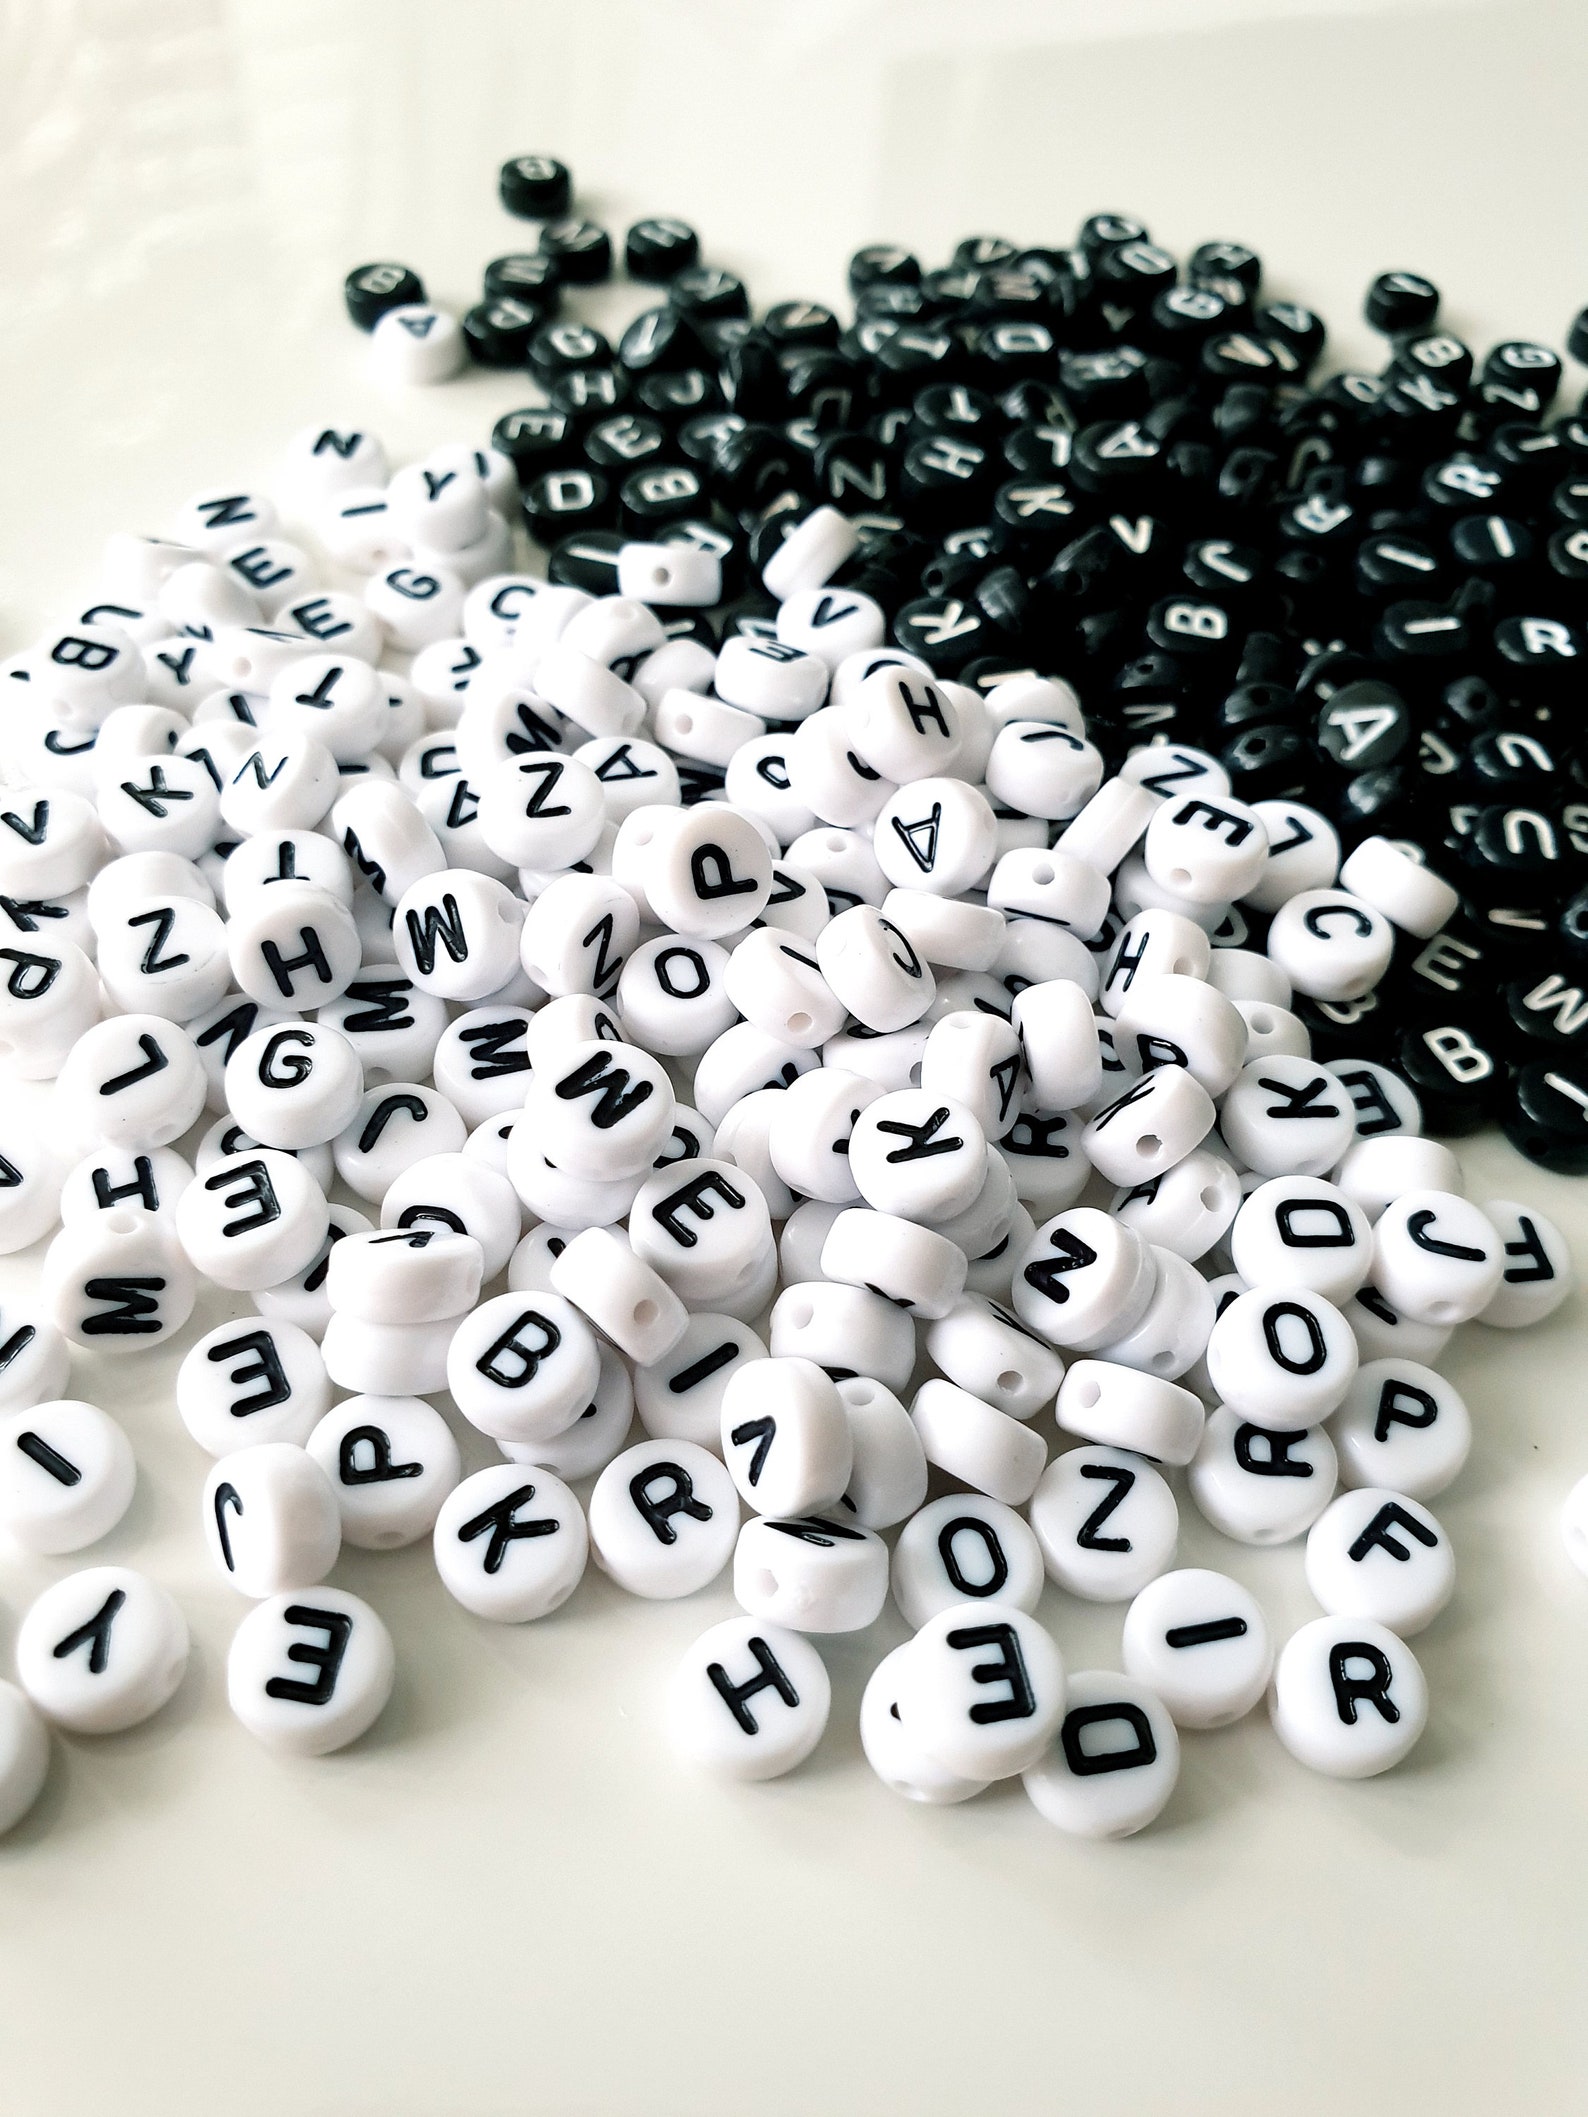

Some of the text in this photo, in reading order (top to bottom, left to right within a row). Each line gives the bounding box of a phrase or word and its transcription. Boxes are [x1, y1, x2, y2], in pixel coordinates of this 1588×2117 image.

[1410, 337, 1464, 368] B
[571, 370, 615, 406] H
[1399, 375, 1457, 411] K
[505, 413, 566, 441] E
[597, 414, 661, 458] E
[1097, 420, 1160, 458] A
[921, 435, 984, 478] H
[1437, 464, 1501, 498] R
[423, 471, 457, 500] Y
[547, 469, 595, 511] D
[639, 467, 699, 501] B
[341, 503, 387, 518] I
[1109, 514, 1154, 554] V
[1376, 544, 1436, 571] I
[1487, 516, 1516, 558] I
[231, 548, 293, 588] E
[386, 569, 440, 600] G
[291, 598, 352, 640] E
[908, 600, 982, 645] K
[1164, 602, 1228, 640] B
[1404, 617, 1460, 634] I
[1519, 617, 1577, 657] R
[51, 637, 120, 671] B
[158, 648, 193, 684] Y
[296, 668, 341, 708] T
[899, 681, 950, 738] H
[1327, 704, 1398, 762] A
[595, 745, 657, 782] A
[121, 766, 193, 817] K
[520, 762, 571, 818] Z
[892, 802, 941, 873] A
[1173, 801, 1253, 846] E
[1503, 808, 1558, 860] U
[691, 843, 758, 900] P
[1305, 906, 1372, 939] C
[261, 926, 333, 997] H
[654, 947, 710, 999] O
[1105, 931, 1149, 992] H
[1410, 934, 1480, 991] E
[100, 1034, 168, 1095] L
[259, 1030, 314, 1088] G
[1423, 1026, 1494, 1084] B
[358, 1094, 428, 1153] J
[1258, 1078, 1339, 1118] K
[1336, 1071, 1402, 1136] E
[877, 1107, 963, 1163] K
[1000, 1111, 1069, 1158] R
[92, 1156, 159, 1211] H
[205, 1160, 281, 1237] E
[652, 1171, 745, 1248] E
[1275, 1199, 1355, 1248] D
[1408, 1210, 1486, 1262] J
[1503, 1216, 1554, 1284] F
[476, 1311, 561, 1388] B
[1263, 1302, 1327, 1375] O
[208, 1331, 291, 1417] E
[667, 1342, 739, 1394] I
[1374, 1379, 1438, 1442] P
[17, 1432, 81, 1486] I
[339, 1425, 423, 1486] P
[1234, 1422, 1313, 1477] R
[458, 1485, 559, 1574] K
[629, 1462, 713, 1545] R
[938, 1517, 1008, 1597] O
[1348, 1502, 1438, 1562] F
[53, 1590, 125, 1674] Y
[266, 1605, 352, 1705] E
[1166, 1617, 1247, 1648] I
[707, 1637, 799, 1735] H
[947, 1623, 1036, 1725] E
[1329, 1642, 1400, 1725] R
[1061, 1703, 1156, 1776] D
